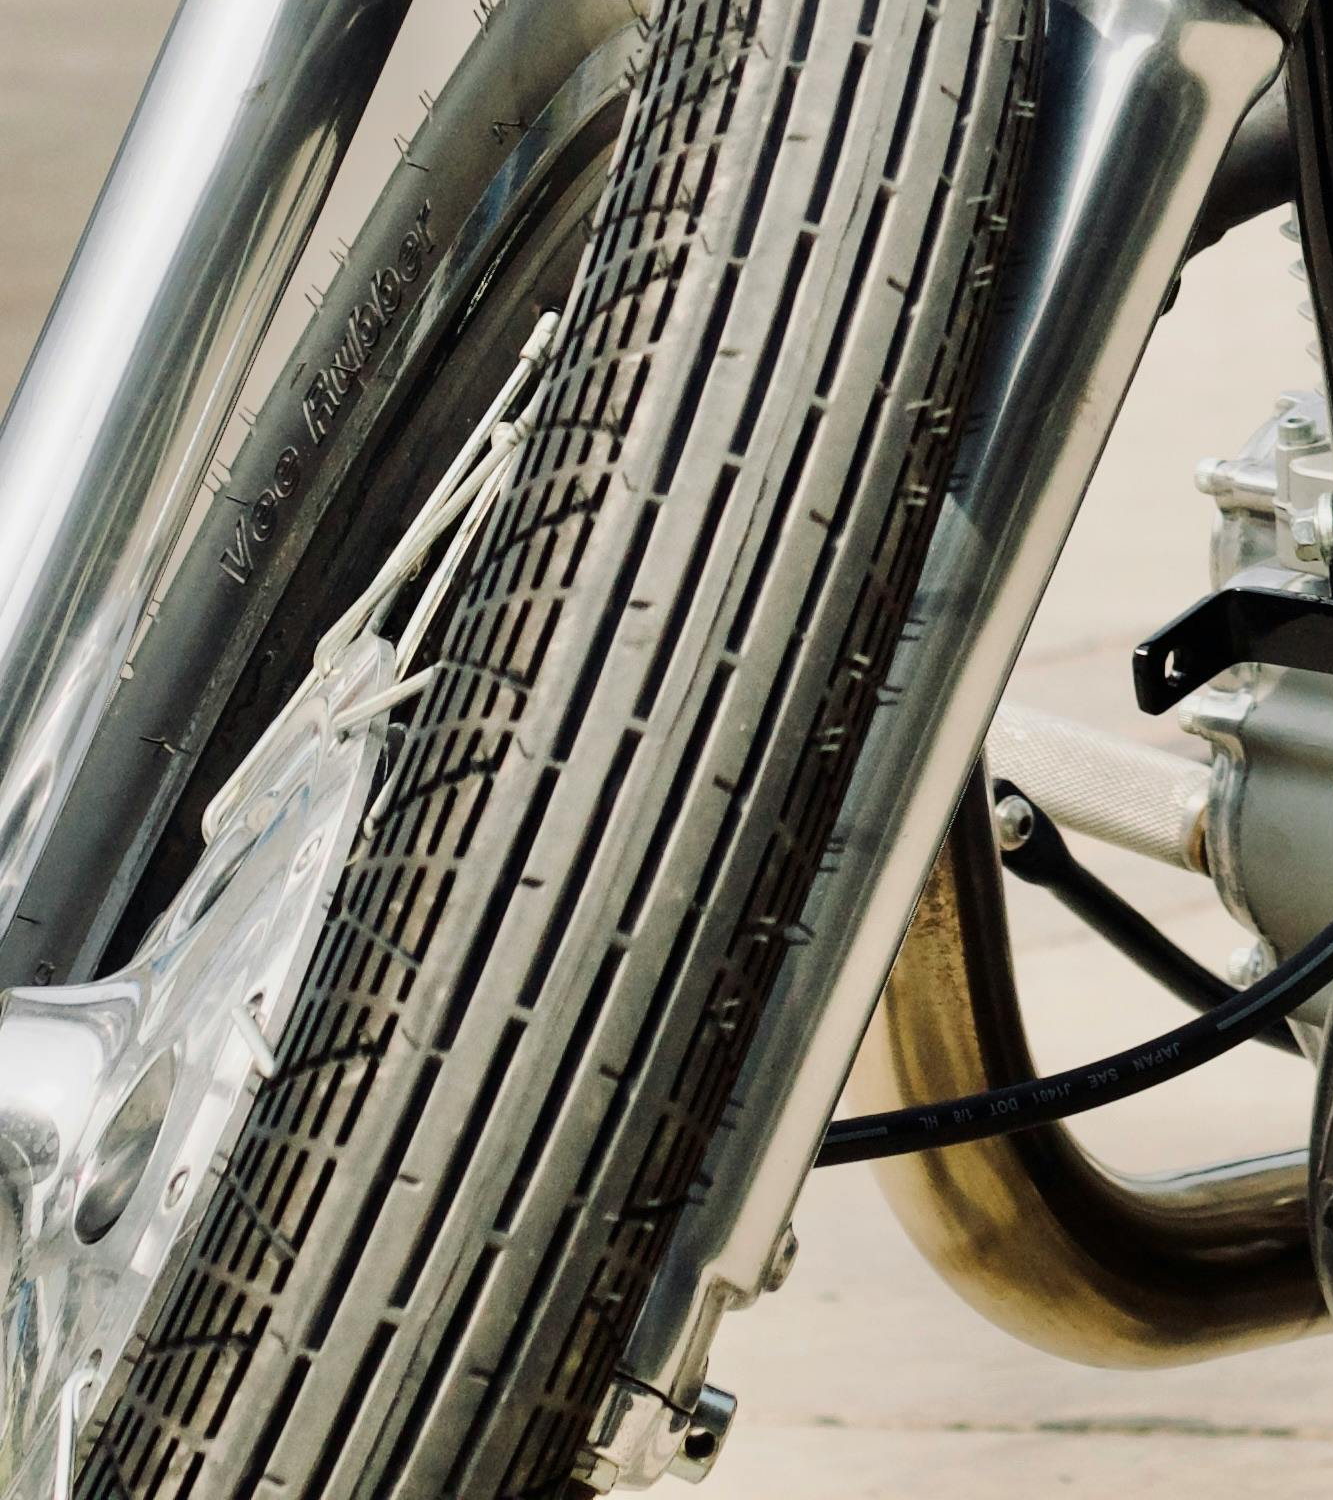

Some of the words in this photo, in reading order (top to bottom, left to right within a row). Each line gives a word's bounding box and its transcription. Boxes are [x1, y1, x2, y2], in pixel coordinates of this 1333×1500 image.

[219, 445, 301, 586] Vee
[302, 198, 437, 445] Rubber
[1132, 1041, 1181, 1072] JAPAN
[1087, 1067, 1120, 1089] SAE
[1032, 1082, 1071, 1105] J1401
[990, 1097, 1019, 1117] DOT
